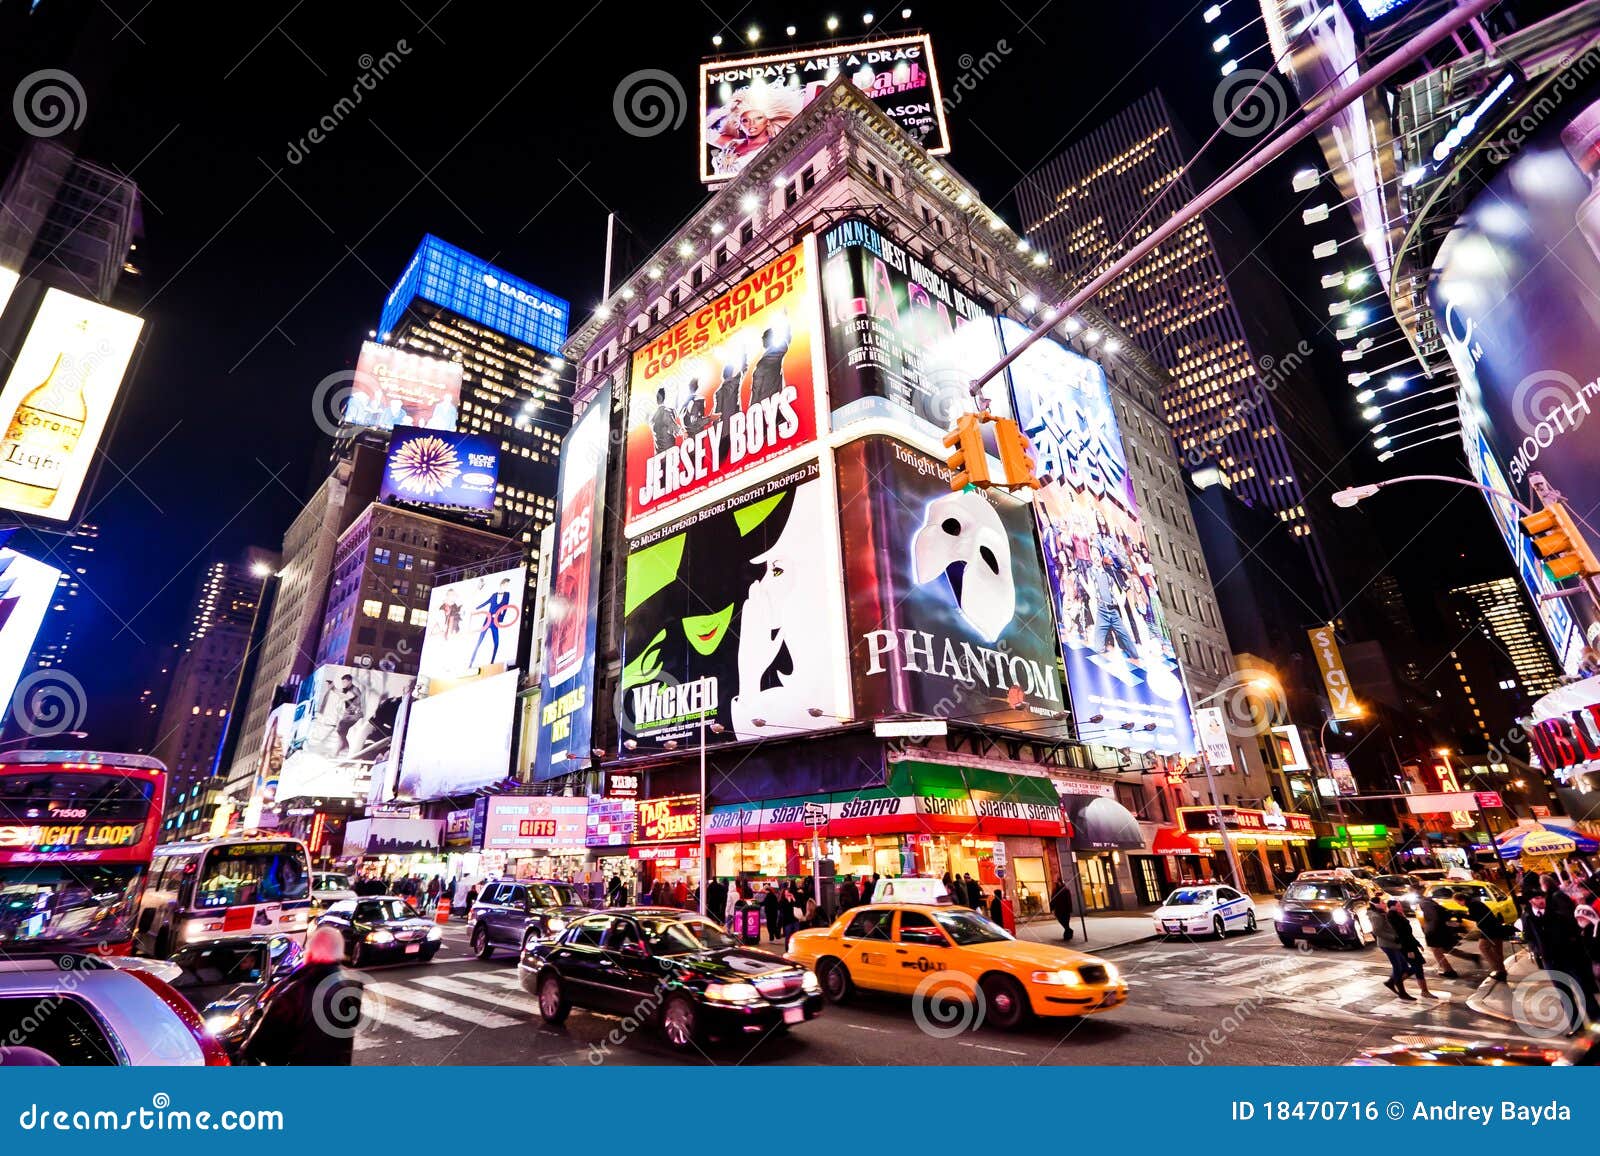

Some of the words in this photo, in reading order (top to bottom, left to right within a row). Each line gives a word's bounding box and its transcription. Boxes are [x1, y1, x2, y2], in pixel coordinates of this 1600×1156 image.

[709, 62, 797, 85] MONDAYS
[803, 55, 840, 72] ARE
[846, 53, 860, 66] A
[867, 47, 920, 64] DRAG
[898, 79, 926, 92] RACE
[886, 102, 931, 117] ASON
[902, 116, 932, 126] 10pm
[826, 221, 881, 252] WINNER!
[880, 236, 908, 274] BEST
[910, 257, 953, 307] MUSICAL
[500, 282, 561, 319] BARCLAYS
[695, 254, 797, 327] CROWD
[644, 328, 710, 380] GOES
[639, 420, 724, 505] JERSEY
[729, 385, 799, 465] BOYS
[892, 442, 936, 476] Tonight
[630, 539, 640, 549] SO
[641, 531, 661, 548] MUCH
[662, 515, 698, 537] HAPPENED
[698, 502, 726, 522] BEFORE
[728, 488, 765, 513] DOROTHY
[767, 469, 806, 493] DROPPED
[807, 463, 819, 475] IN
[863, 628, 1059, 703] PHANTOM
[1314, 632, 1349, 709] stay
[632, 677, 718, 725] WICKED
[770, 803, 805, 824] sbar
[840, 797, 900, 818] sbarro
[924, 794, 968, 815] sbarro
[979, 801, 1019, 818] sbarro
[1027, 805, 1061, 821] sbarr
[520, 821, 555, 836] GIFTS
[710, 808, 752, 828] sbarro
[85, 825, 134, 845] LOOP
[1528, 843, 1573, 854] SABRETT
